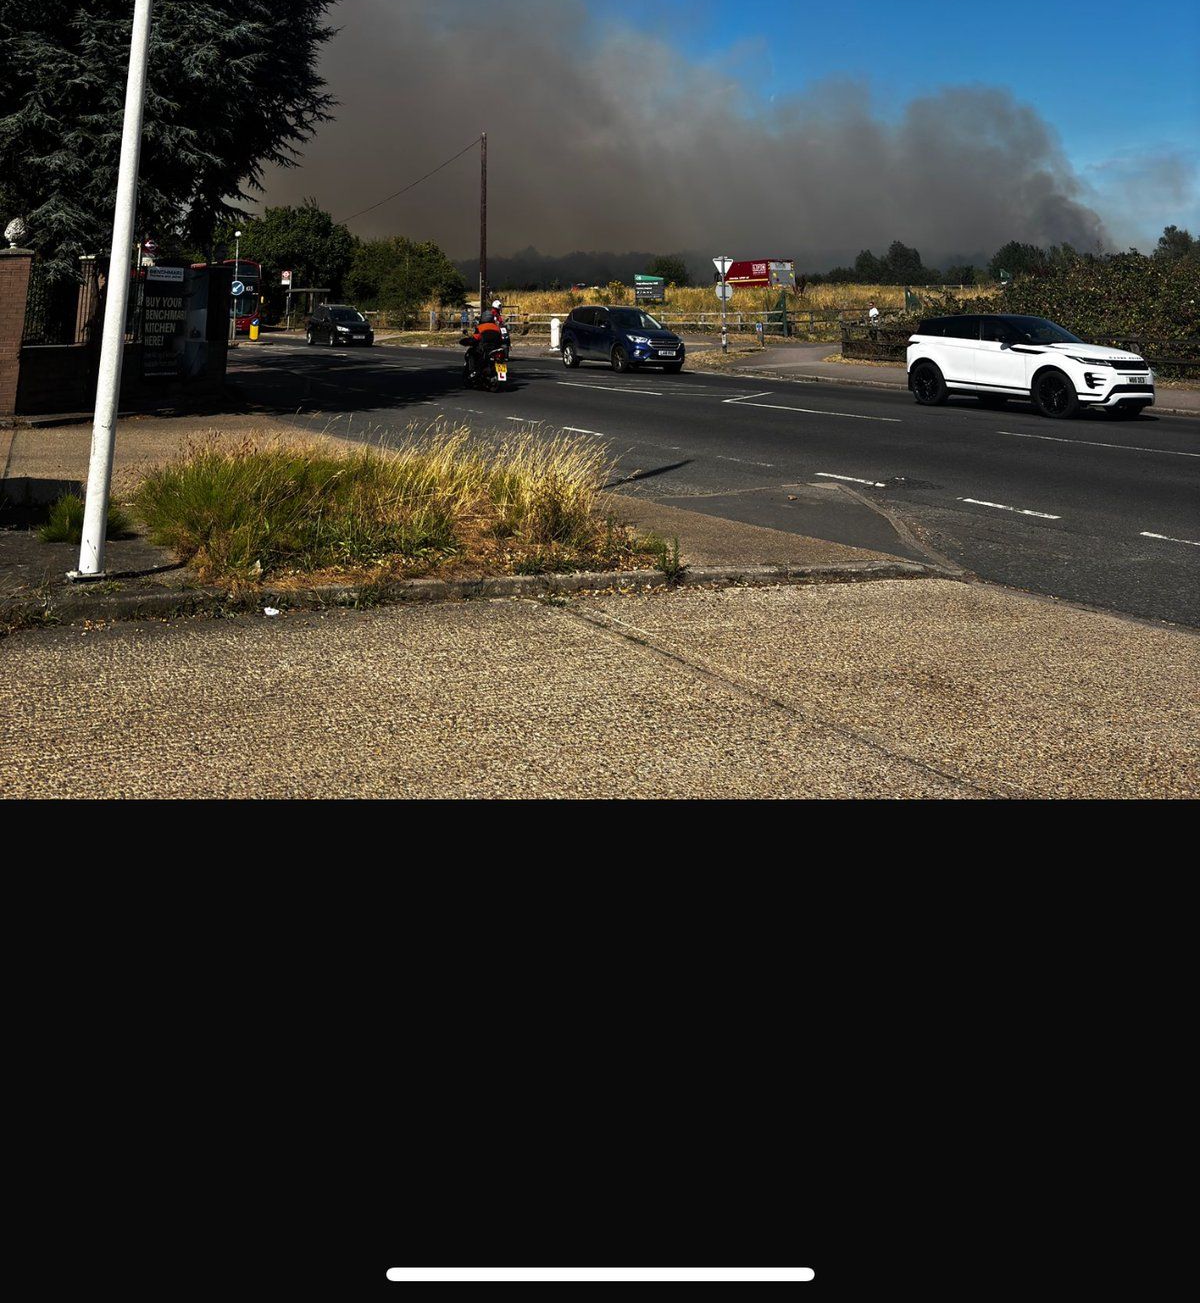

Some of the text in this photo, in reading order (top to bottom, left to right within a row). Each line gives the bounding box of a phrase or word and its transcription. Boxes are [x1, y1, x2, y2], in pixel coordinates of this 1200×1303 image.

[146, 296, 183, 308] BUY YOUR
[145, 322, 176, 334] KITCHEN
[144, 335, 164, 346] HERE!
